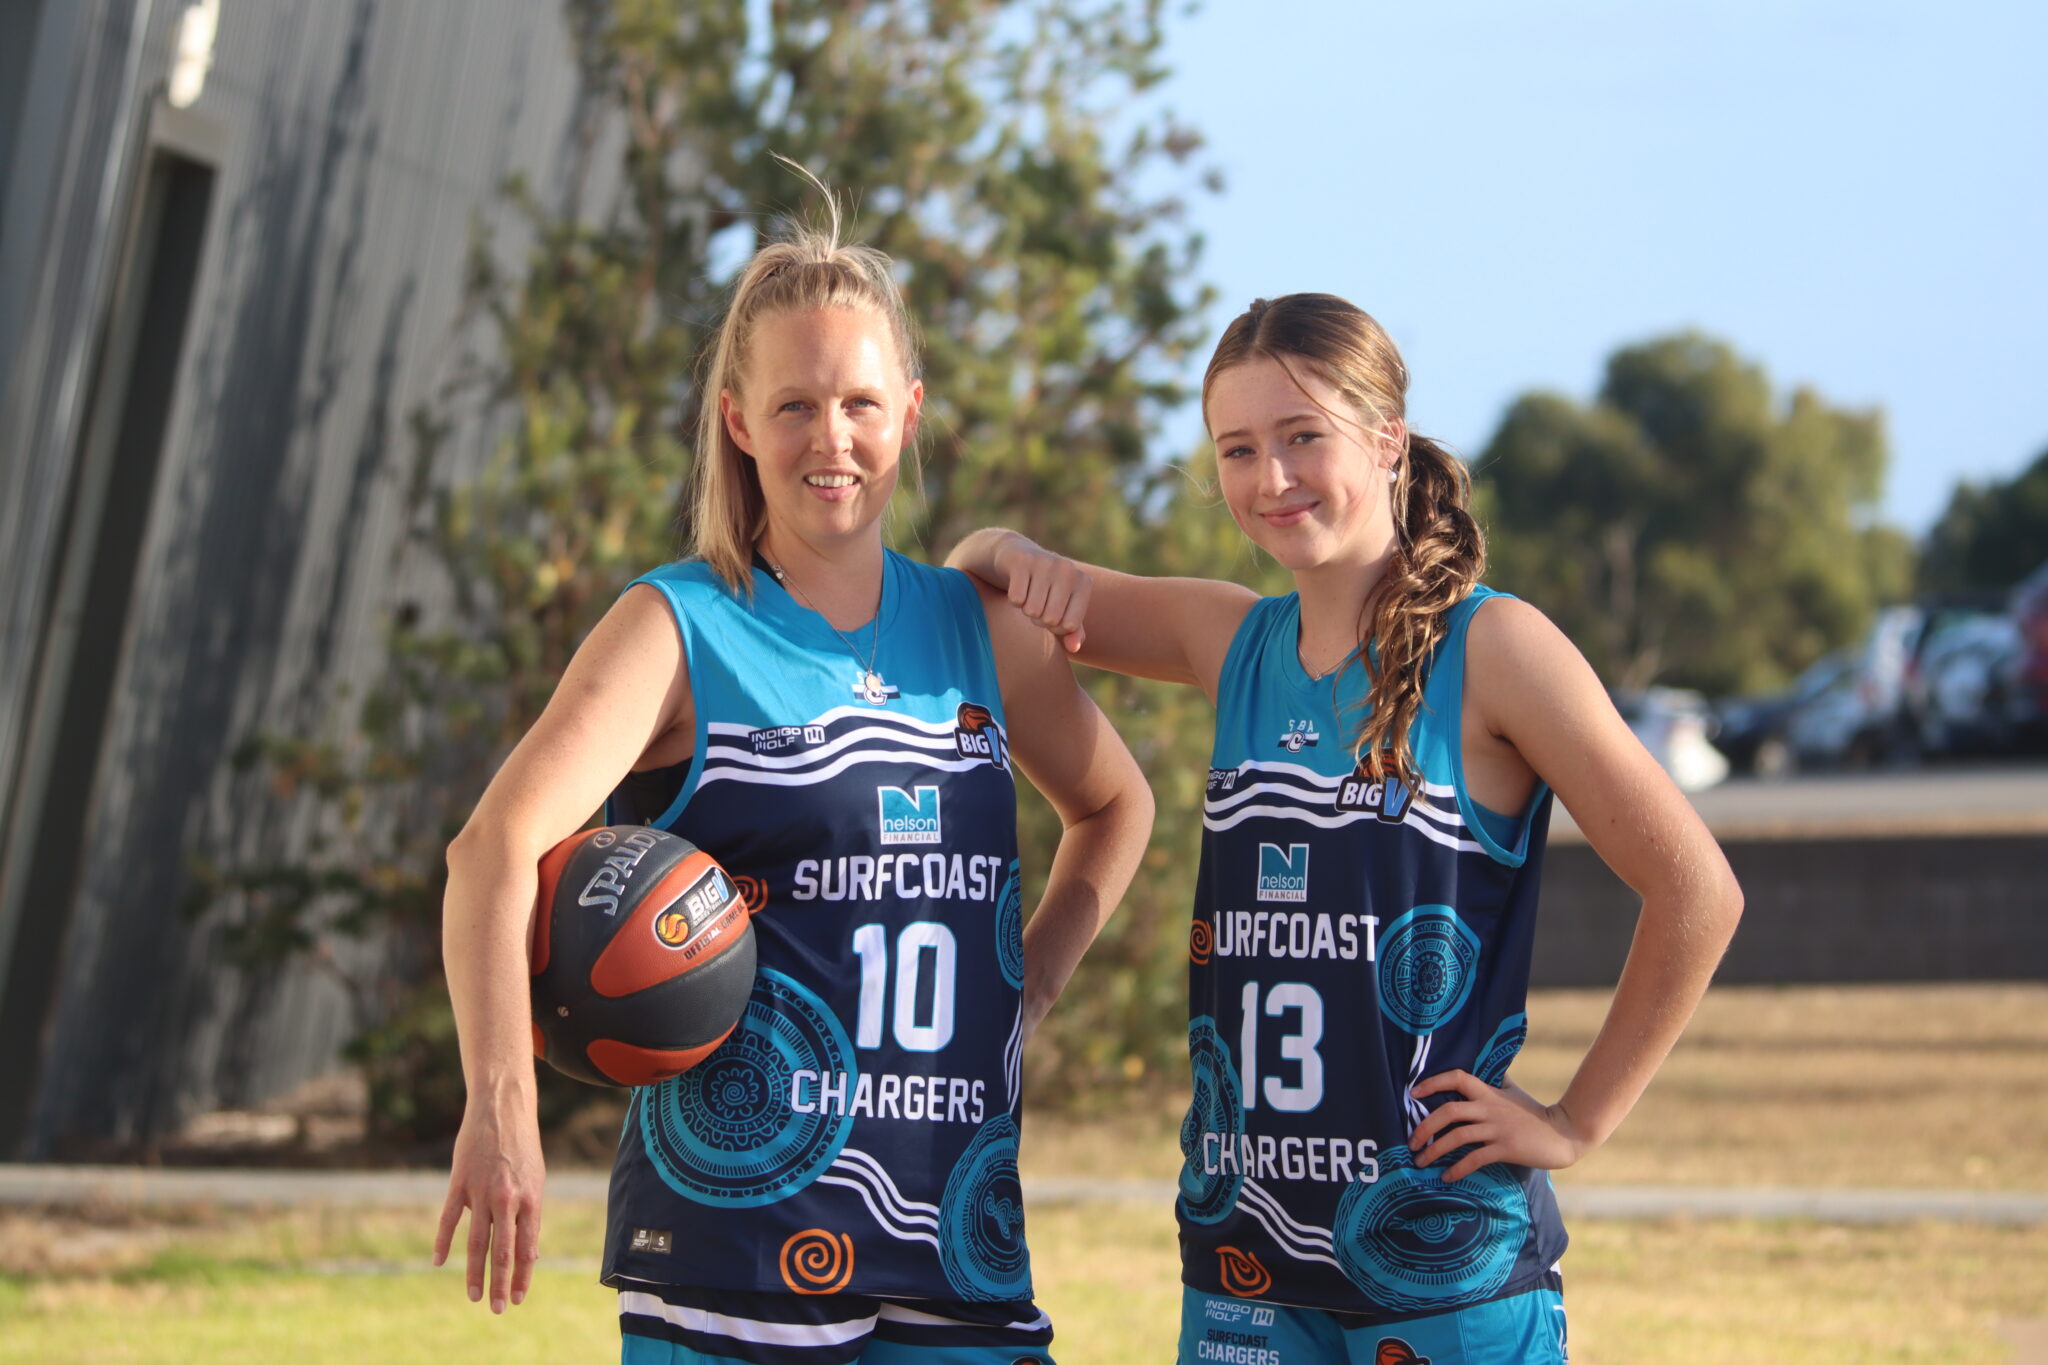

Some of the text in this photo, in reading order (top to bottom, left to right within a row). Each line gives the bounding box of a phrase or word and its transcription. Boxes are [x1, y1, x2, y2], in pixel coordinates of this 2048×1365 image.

[856, 672, 885, 685] SA
[751, 727, 801, 742] INDIGO
[1289, 720, 1314, 733] SBA
[884, 815, 937, 831] nelson
[883, 832, 939, 842] FINANCIAL
[792, 853, 1002, 902] SURFCOAST
[1261, 873, 1304, 889] nelson
[1259, 890, 1305, 900] FINANCIAL
[683, 927, 721, 960] OFFICIAL
[1213, 911, 1379, 961] URFCOAST
[852, 920, 957, 1052] 10
[1241, 981, 1324, 1112] 13
[791, 1069, 985, 1124] CHARGERS
[1203, 1131, 1380, 1184] CHARGERS
[1205, 1299, 1251, 1314] INDIGO
[1207, 1328, 1268, 1348] SURFCOAST
[1198, 1340, 1280, 1365] CHARGERS
